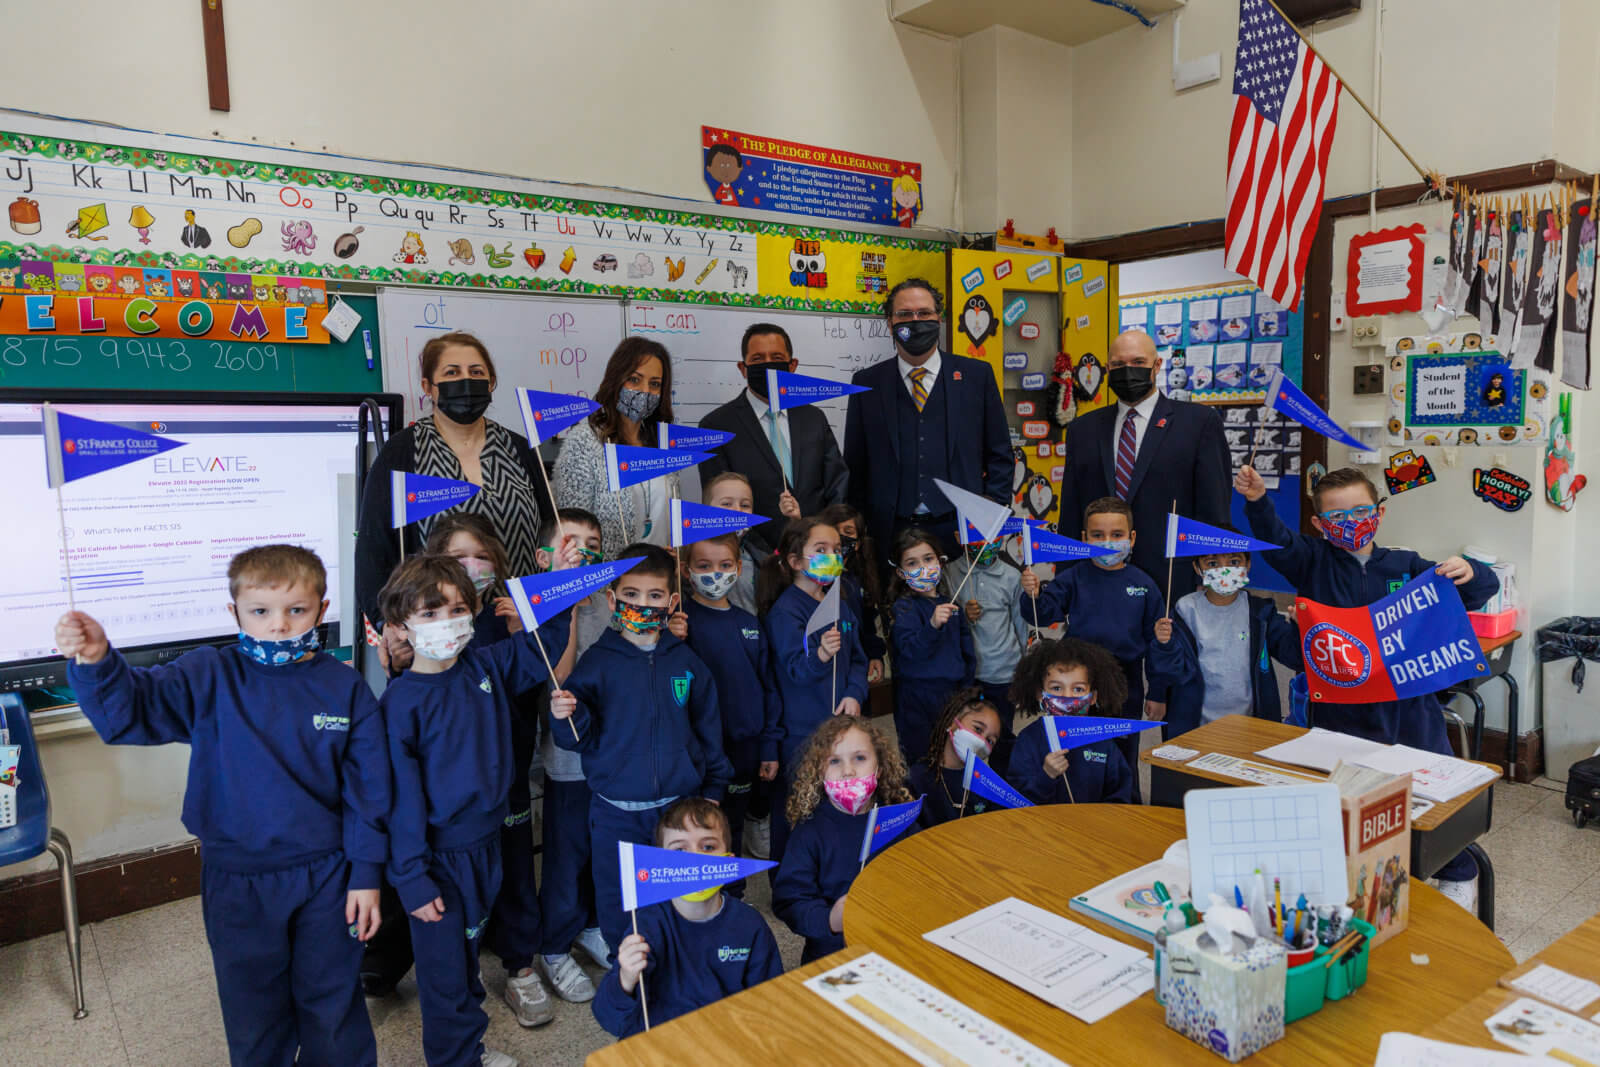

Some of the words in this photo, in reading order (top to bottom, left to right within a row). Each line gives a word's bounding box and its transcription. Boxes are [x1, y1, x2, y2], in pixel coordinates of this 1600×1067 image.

[740, 136, 766, 152] THE
[768, 142, 811, 160] PLEDGE
[813, 151, 827, 162] OF
[830, 152, 892, 172] ALLEGIANCE
[6, 158, 33, 193] Jj
[72, 164, 103, 190] Kk
[169, 175, 212, 200] Mm
[226, 180, 256, 203] Nn
[279, 187, 313, 209] Oo
[335, 192, 358, 222] Pp
[379, 198, 408, 221] Qu
[413, 208, 434, 230] qu
[449, 204, 468, 225] Rr
[487, 208, 505, 229] Ss
[520, 212, 539, 232] Tt
[557, 216, 576, 236] Uu
[593, 221, 613, 240] Vv
[625, 224, 652, 244] Ww
[663, 228, 682, 246] Xx
[696, 232, 715, 256] Yy
[729, 235, 744, 253] Zz
[795, 238, 820, 256] EYES
[790, 272, 807, 287] ON
[807, 272, 828, 288] ME
[0, 294, 309, 339] ELCOME
[548, 311, 576, 337] op
[633, 306, 656, 329] I
[666, 311, 697, 330] can
[100, 338, 192, 371] 9943
[209, 343, 279, 371] 2609
[540, 347, 587, 378] mop
[1423, 372, 1461, 382] Student
[819, 385, 843, 393] COLLEGE
[1428, 387, 1438, 396] of
[1439, 387, 1456, 395] the
[1426, 402, 1457, 410] Month
[126, 438, 159, 449] COLLEGE
[153, 456, 248, 474] ELEVATE
[666, 455, 693, 464] COLLEGE
[1482, 475, 1530, 499] HOORAY!
[724, 516, 748, 524] COLLEGE
[1223, 537, 1249, 546] COLLEGE
[583, 565, 616, 582] COLLEGE
[1375, 582, 1440, 632] DRIVEN
[1380, 628, 1406, 657] BY
[1313, 632, 1358, 675] SFC
[1390, 638, 1476, 685] DREAMS
[1104, 722, 1131, 730] COLLEGE
[1363, 803, 1402, 843] BIBLE
[701, 863, 739, 874] COLLEGE
